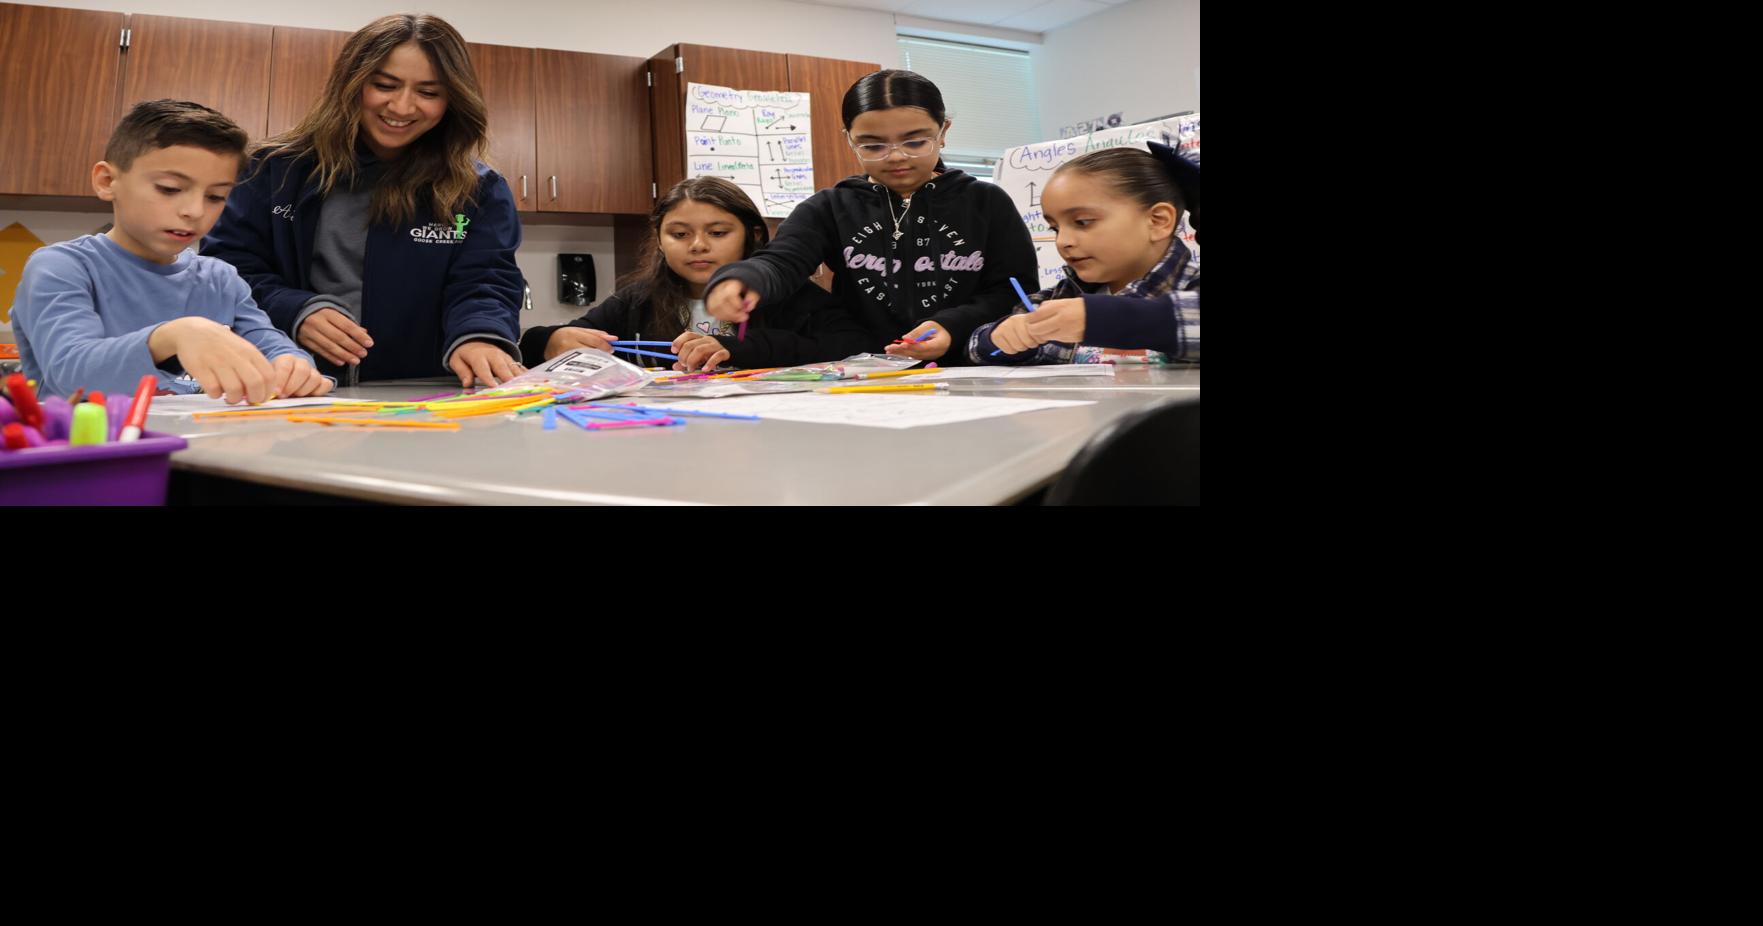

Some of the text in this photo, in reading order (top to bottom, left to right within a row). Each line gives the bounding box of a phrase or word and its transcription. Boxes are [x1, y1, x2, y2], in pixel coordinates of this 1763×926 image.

[691, 104, 714, 114] Plane
[1019, 142, 1077, 163] Angles
[693, 160, 714, 171] Line
[410, 228, 468, 240] GIANTS
